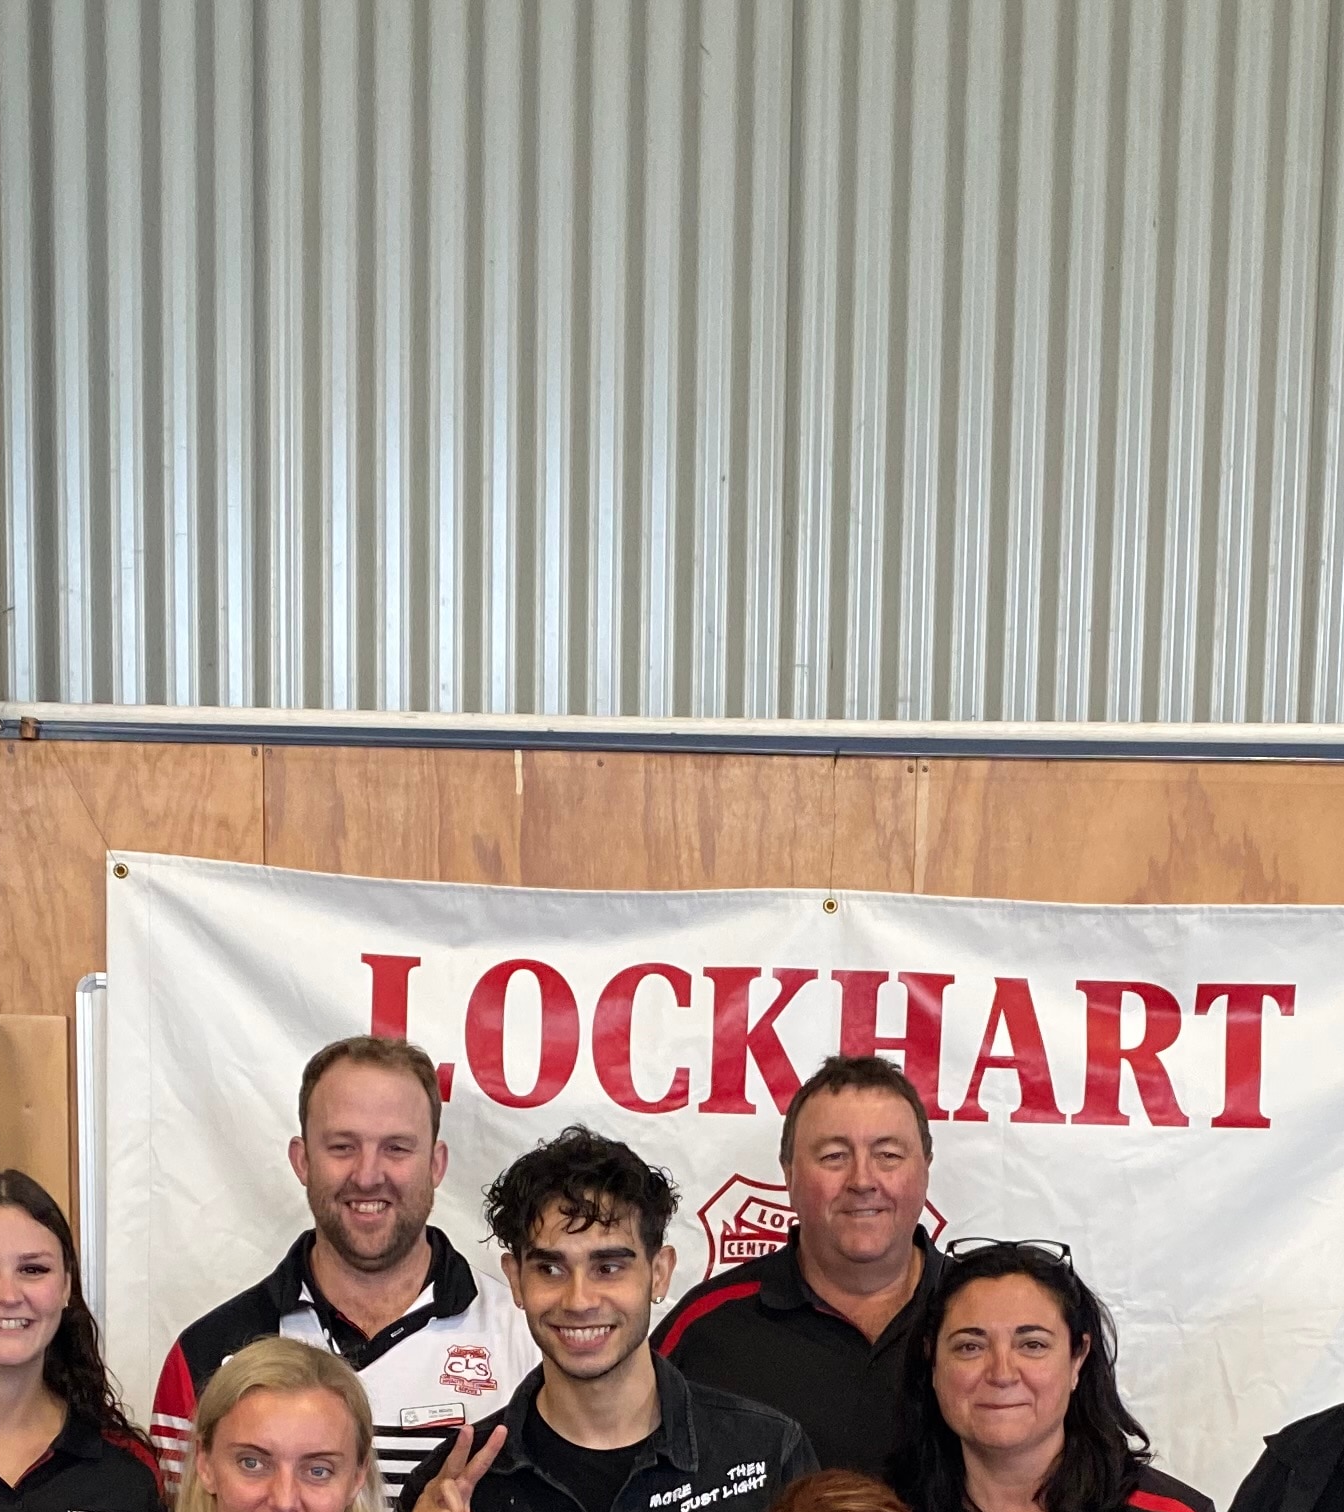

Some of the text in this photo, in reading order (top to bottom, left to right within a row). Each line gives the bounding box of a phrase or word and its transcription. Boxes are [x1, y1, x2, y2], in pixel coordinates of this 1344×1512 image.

[360, 952, 1297, 1130] LOCKHART
[447, 1359, 489, 1376] CLS
[649, 1461, 766, 1508] MORE THEN
[722, 1475, 768, 1499] LIGHT
